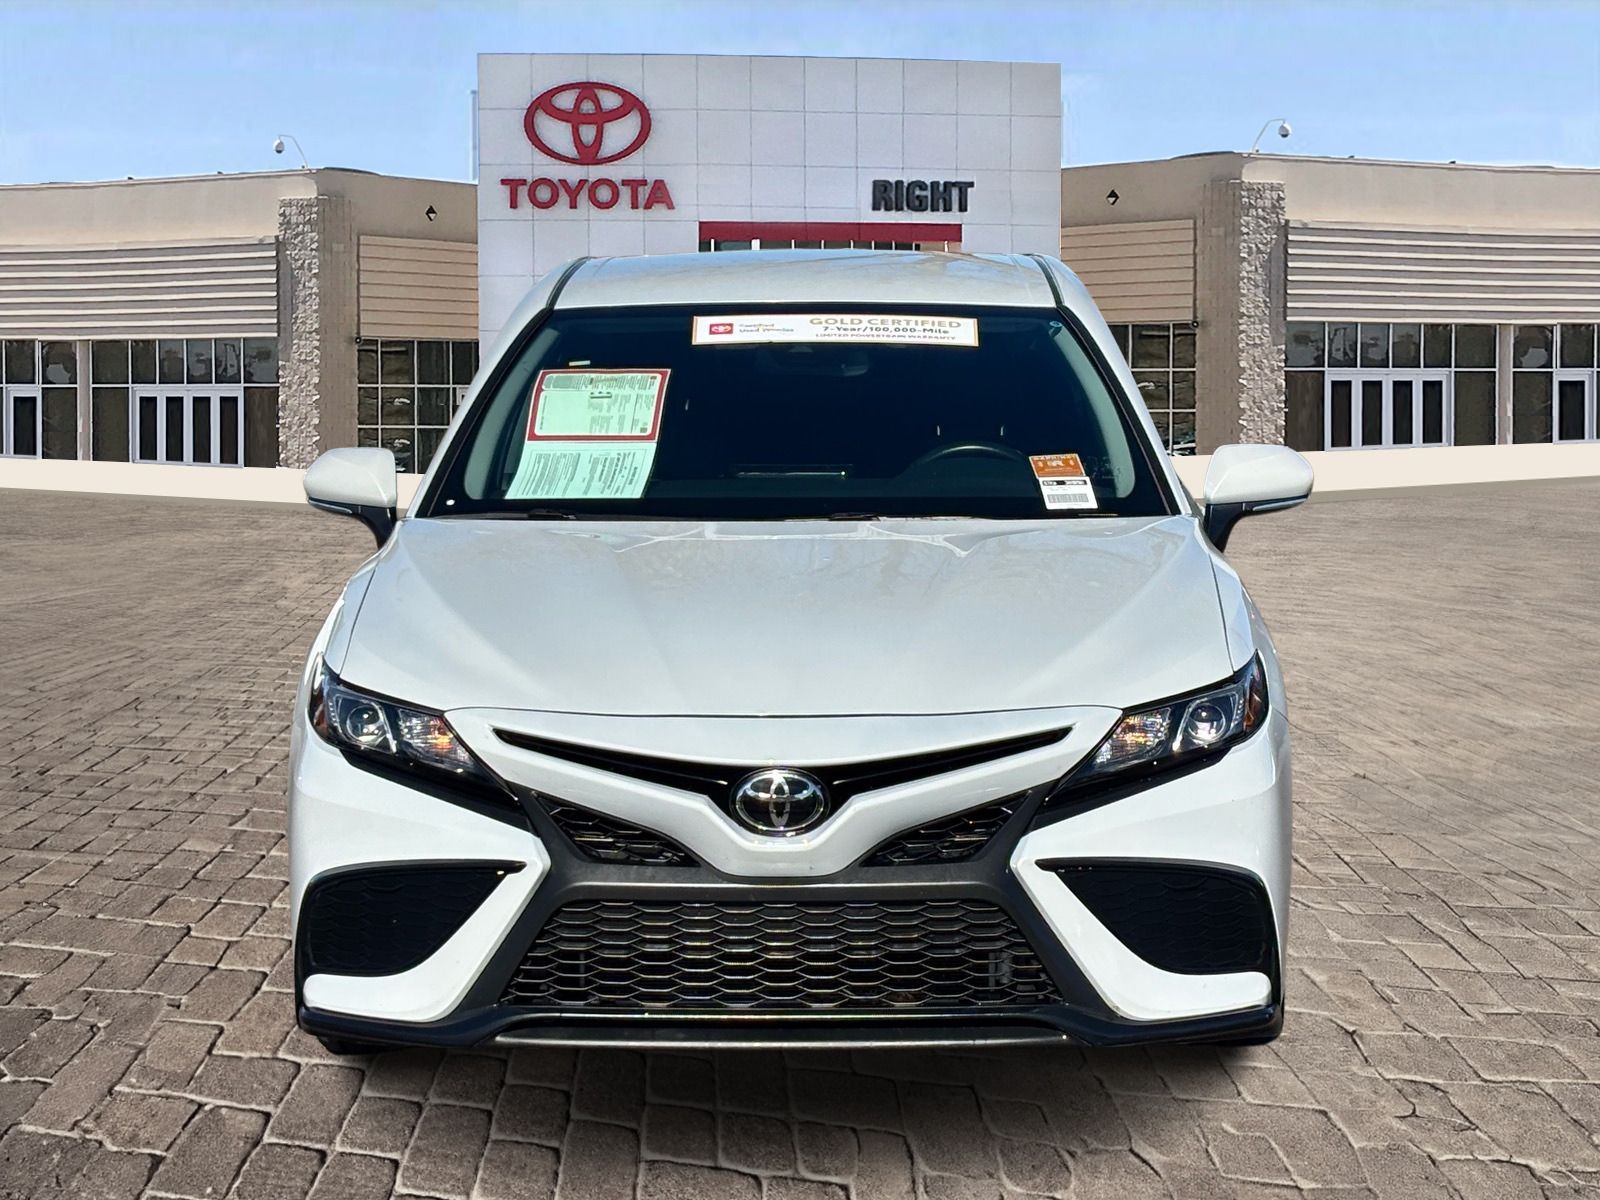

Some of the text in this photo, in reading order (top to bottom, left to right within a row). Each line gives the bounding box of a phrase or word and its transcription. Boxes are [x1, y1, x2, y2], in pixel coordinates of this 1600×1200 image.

[500, 177, 675, 210] TOYOTA
[872, 179, 975, 212] RIGHT
[809, 318, 962, 328] GOLD CERTIFIED
[822, 326, 950, 334] 7-Year/100,000-Mile
